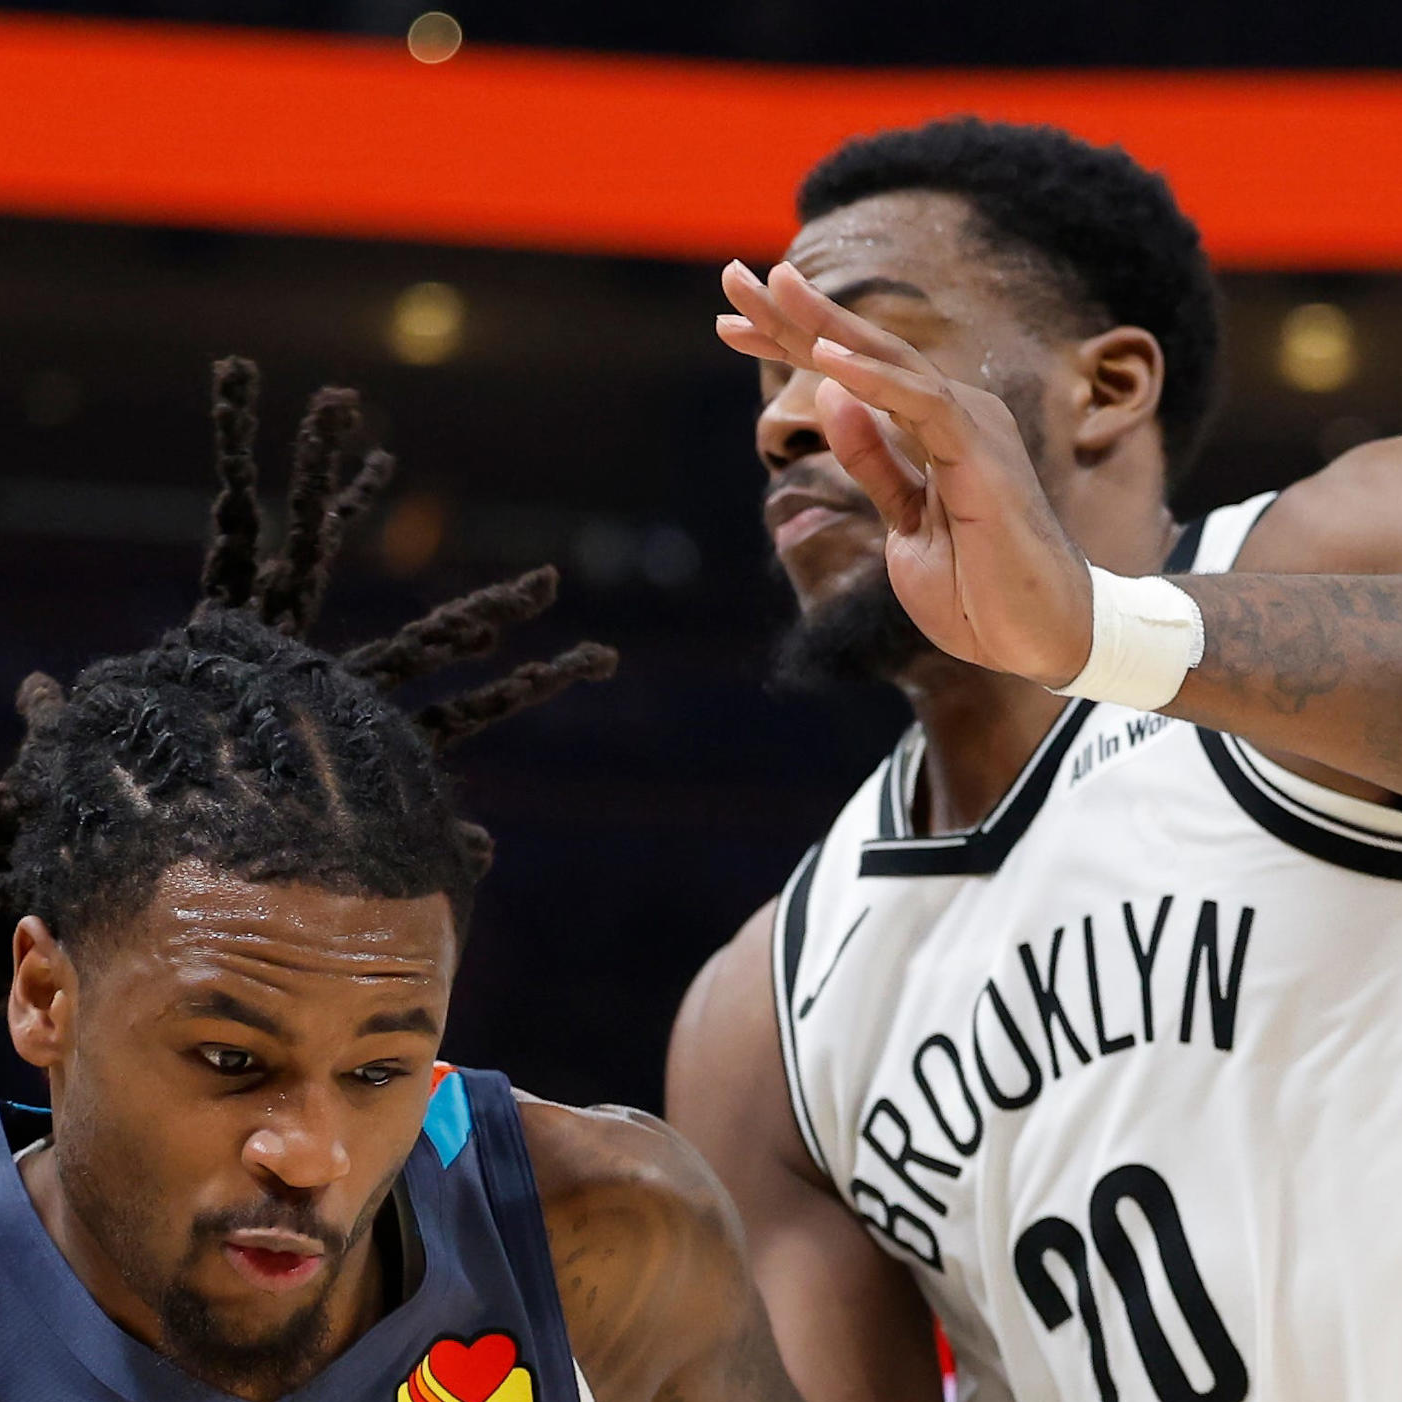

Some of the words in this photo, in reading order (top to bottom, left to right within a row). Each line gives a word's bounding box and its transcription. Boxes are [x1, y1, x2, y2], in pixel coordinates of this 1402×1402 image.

[1070, 742, 1093, 788] All
[1099, 733, 1119, 763] In
[850, 894, 1255, 1273] BROOKLYN
